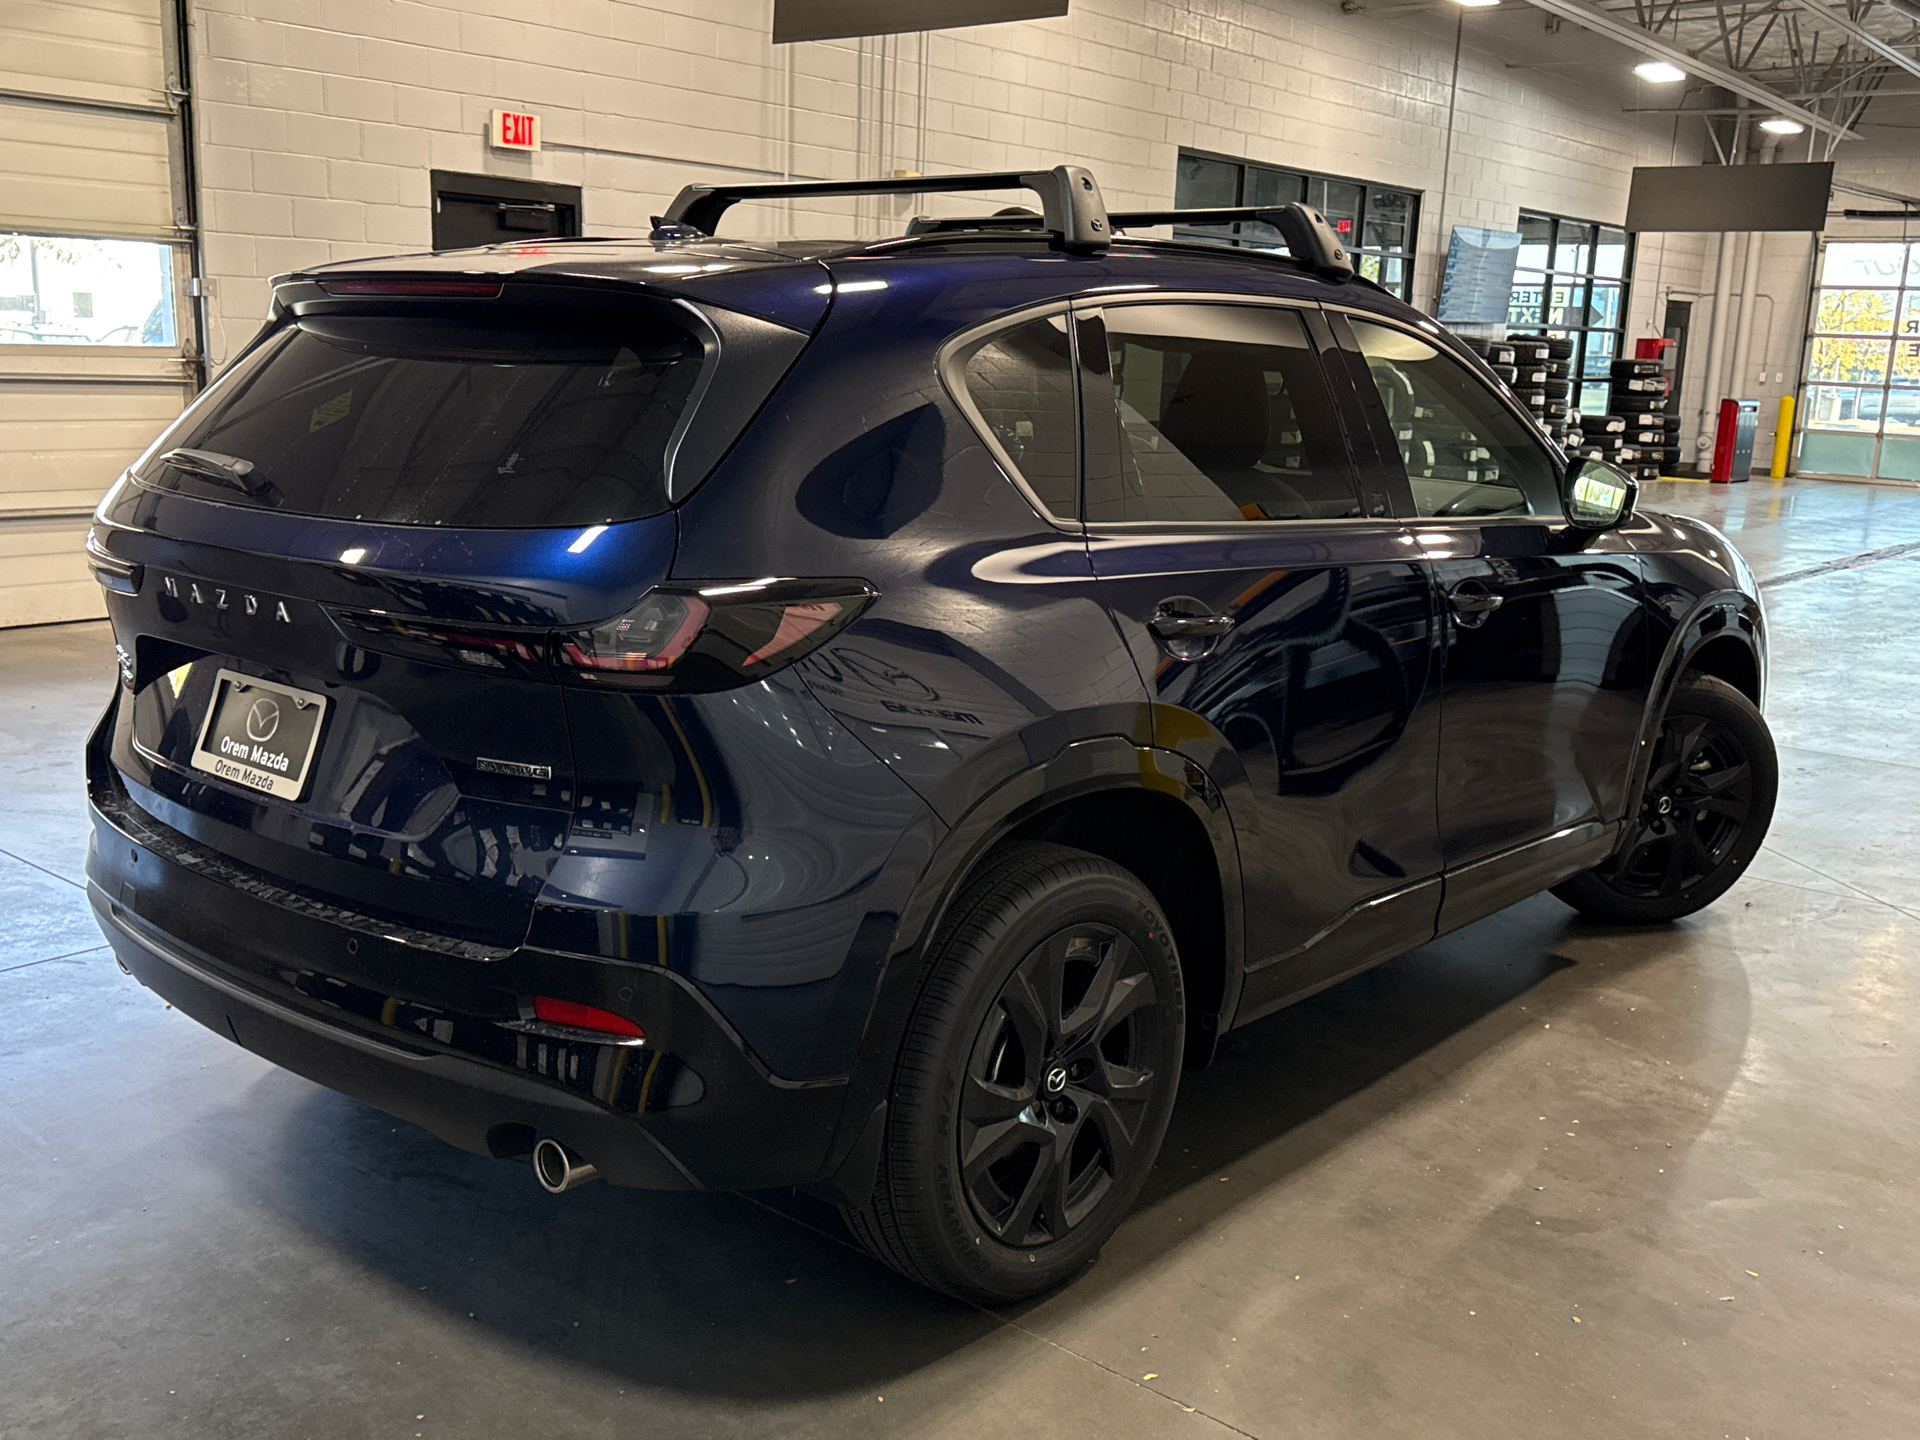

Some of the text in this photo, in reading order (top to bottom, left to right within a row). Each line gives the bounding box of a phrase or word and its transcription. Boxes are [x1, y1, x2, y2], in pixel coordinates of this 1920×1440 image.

[502, 112, 535, 147] EXIT
[164, 576, 292, 623] MAZDA
[220, 735, 290, 772] Orem Mazda
[214, 759, 275, 791] Orem Mazda
[1135, 899, 1185, 1025] TOYO TIRES
